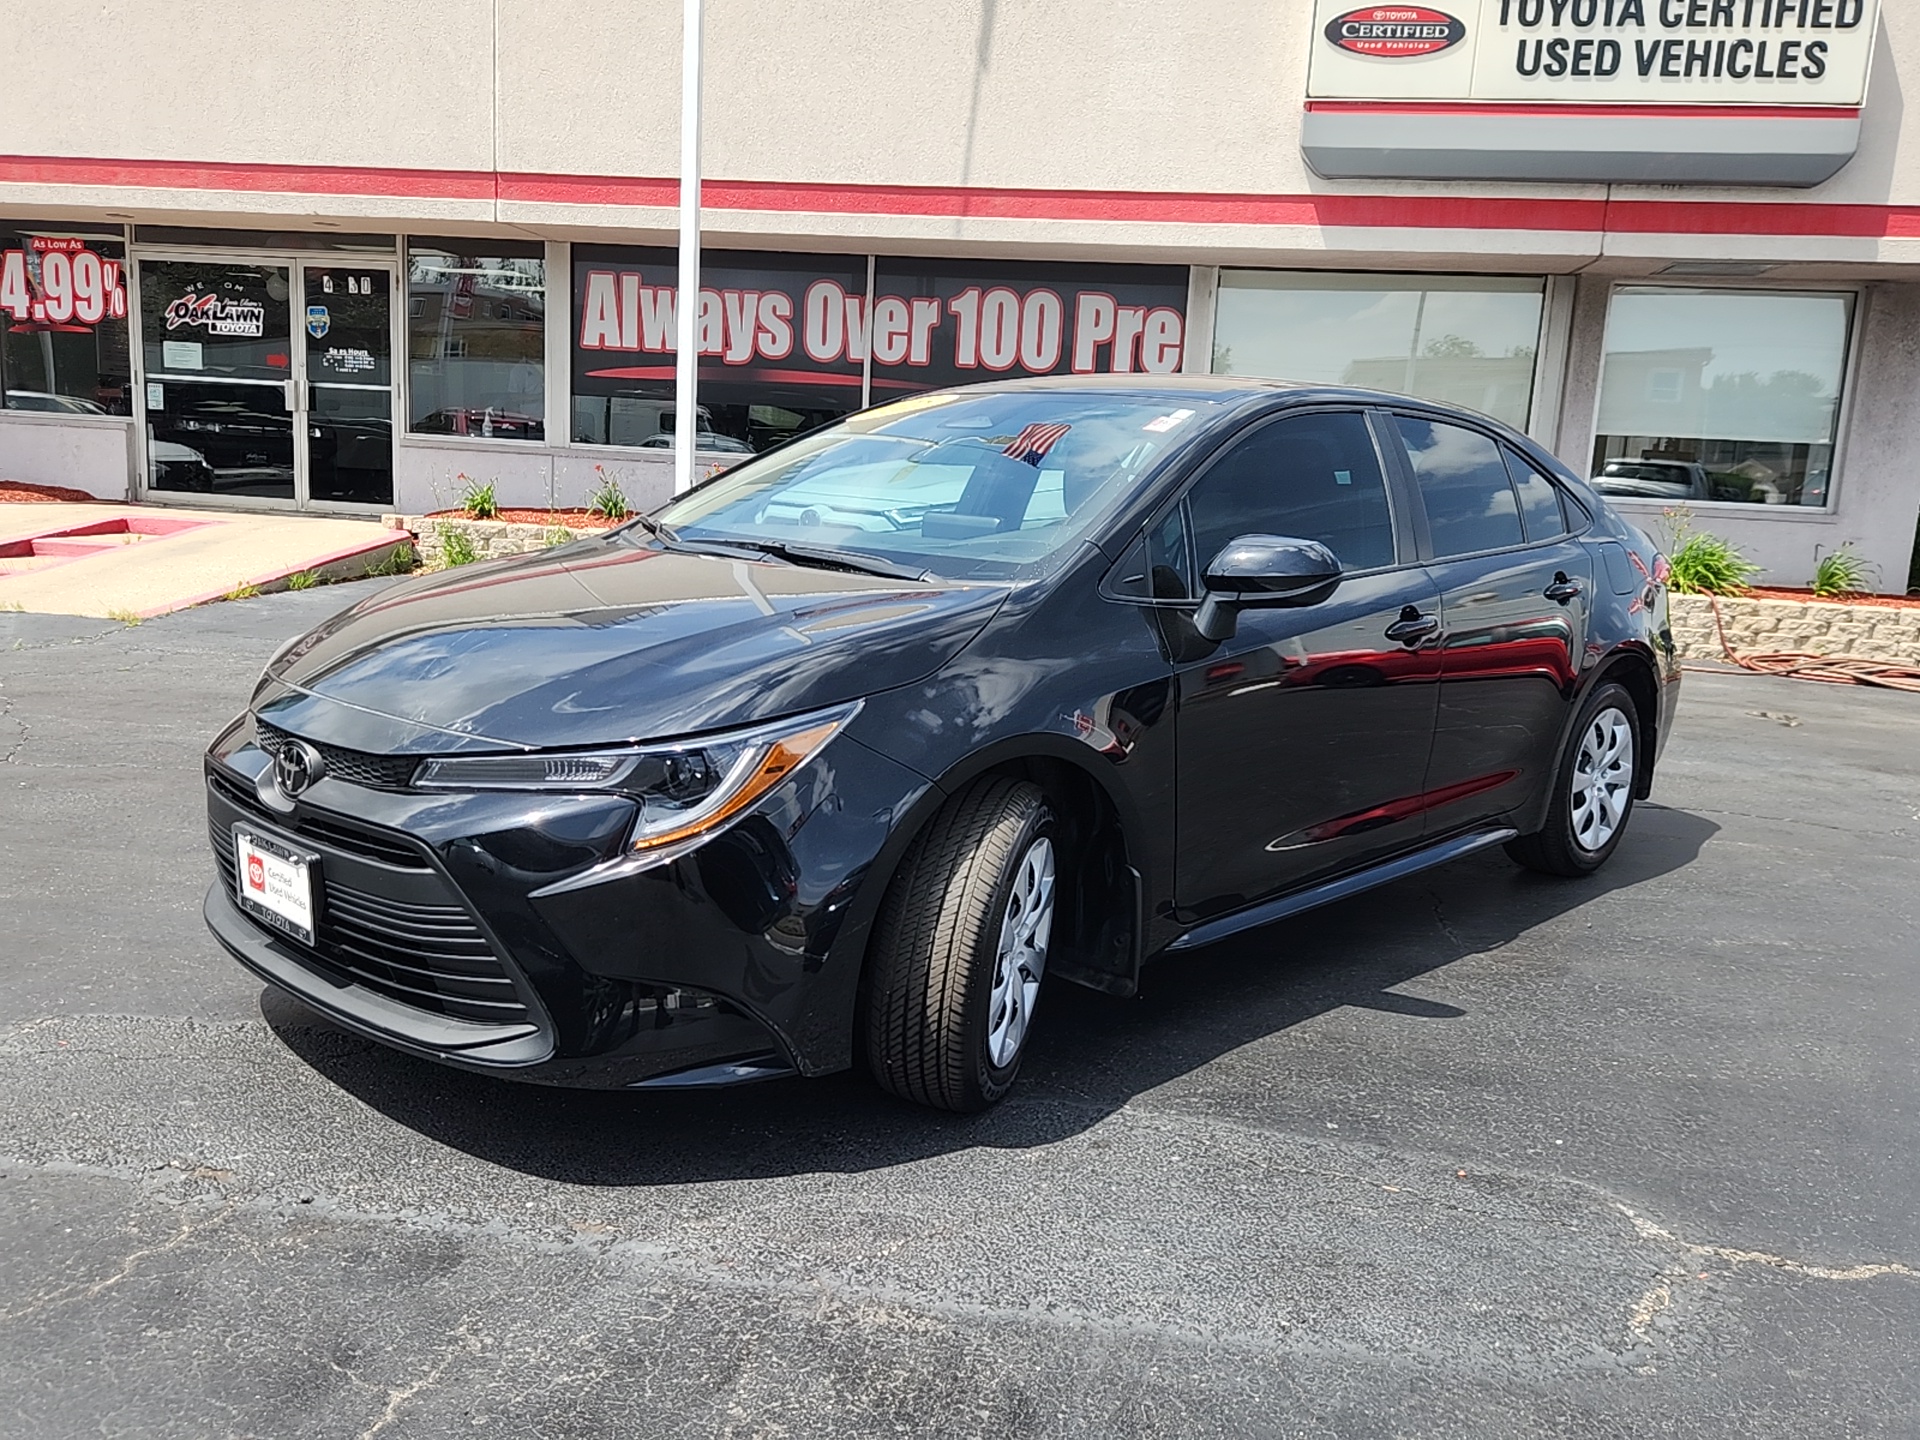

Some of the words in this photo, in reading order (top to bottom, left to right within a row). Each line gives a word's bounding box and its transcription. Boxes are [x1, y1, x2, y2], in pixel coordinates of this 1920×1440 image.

[1386, 12, 1418, 20] TOYOTA
[1499, 0, 1645, 28] TOYOTA
[1659, 0, 1863, 29] CERTIFIED
[1341, 22, 1450, 38] CERTIFIED
[1357, 41, 1383, 49] Used
[1516, 38, 1621, 77] USED
[1635, 38, 1829, 79] VEHICLES
[33, 240, 46, 248] As
[48, 240, 67, 248] Low
[70, 241, 82, 249] As
[0, 250, 127, 323] 4.99%
[215, 323, 258, 333] TOYOTA
[581, 271, 793, 364] Always
[804, 279, 941, 366] Over
[948, 286, 1064, 373] 100
[1072, 290, 1184, 373] Pre
[261, 907, 291, 931] TOYOTA
